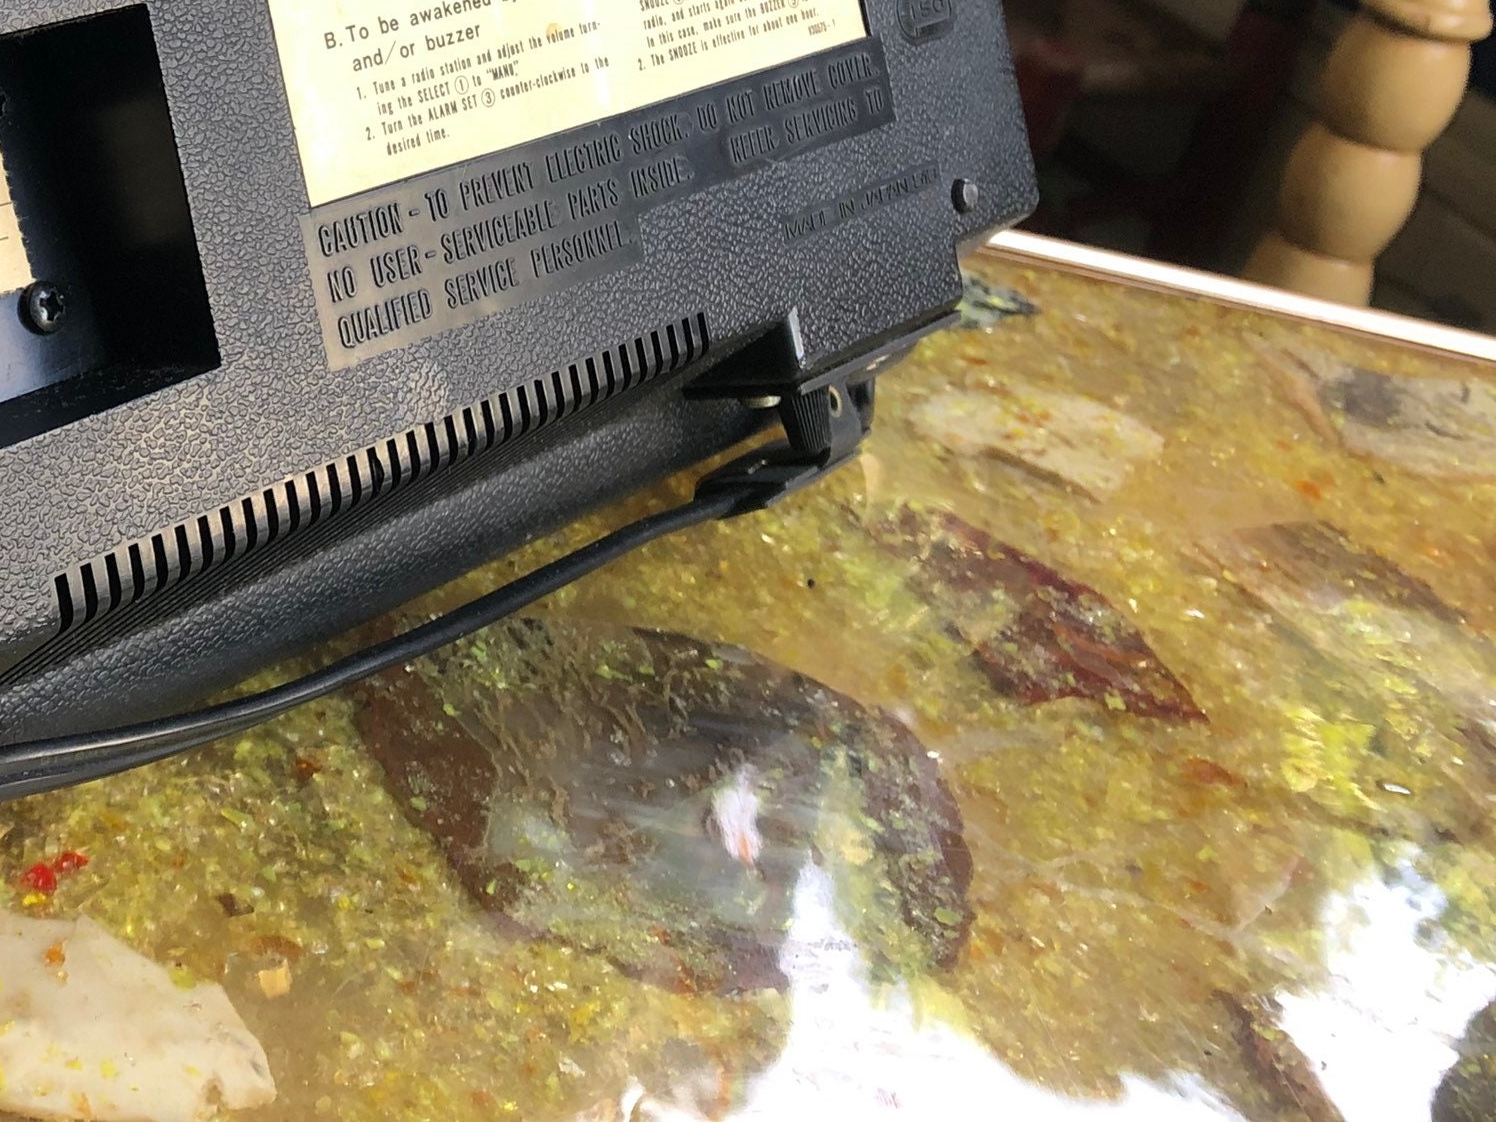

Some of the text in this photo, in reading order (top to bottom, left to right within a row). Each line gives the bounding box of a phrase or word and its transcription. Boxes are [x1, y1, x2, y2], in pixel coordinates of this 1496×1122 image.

[344, 23, 370, 43] To
[377, 16, 400, 35] be
[352, 24, 480, 72] and/or buzzer
[386, 127, 450, 156] desired time.
